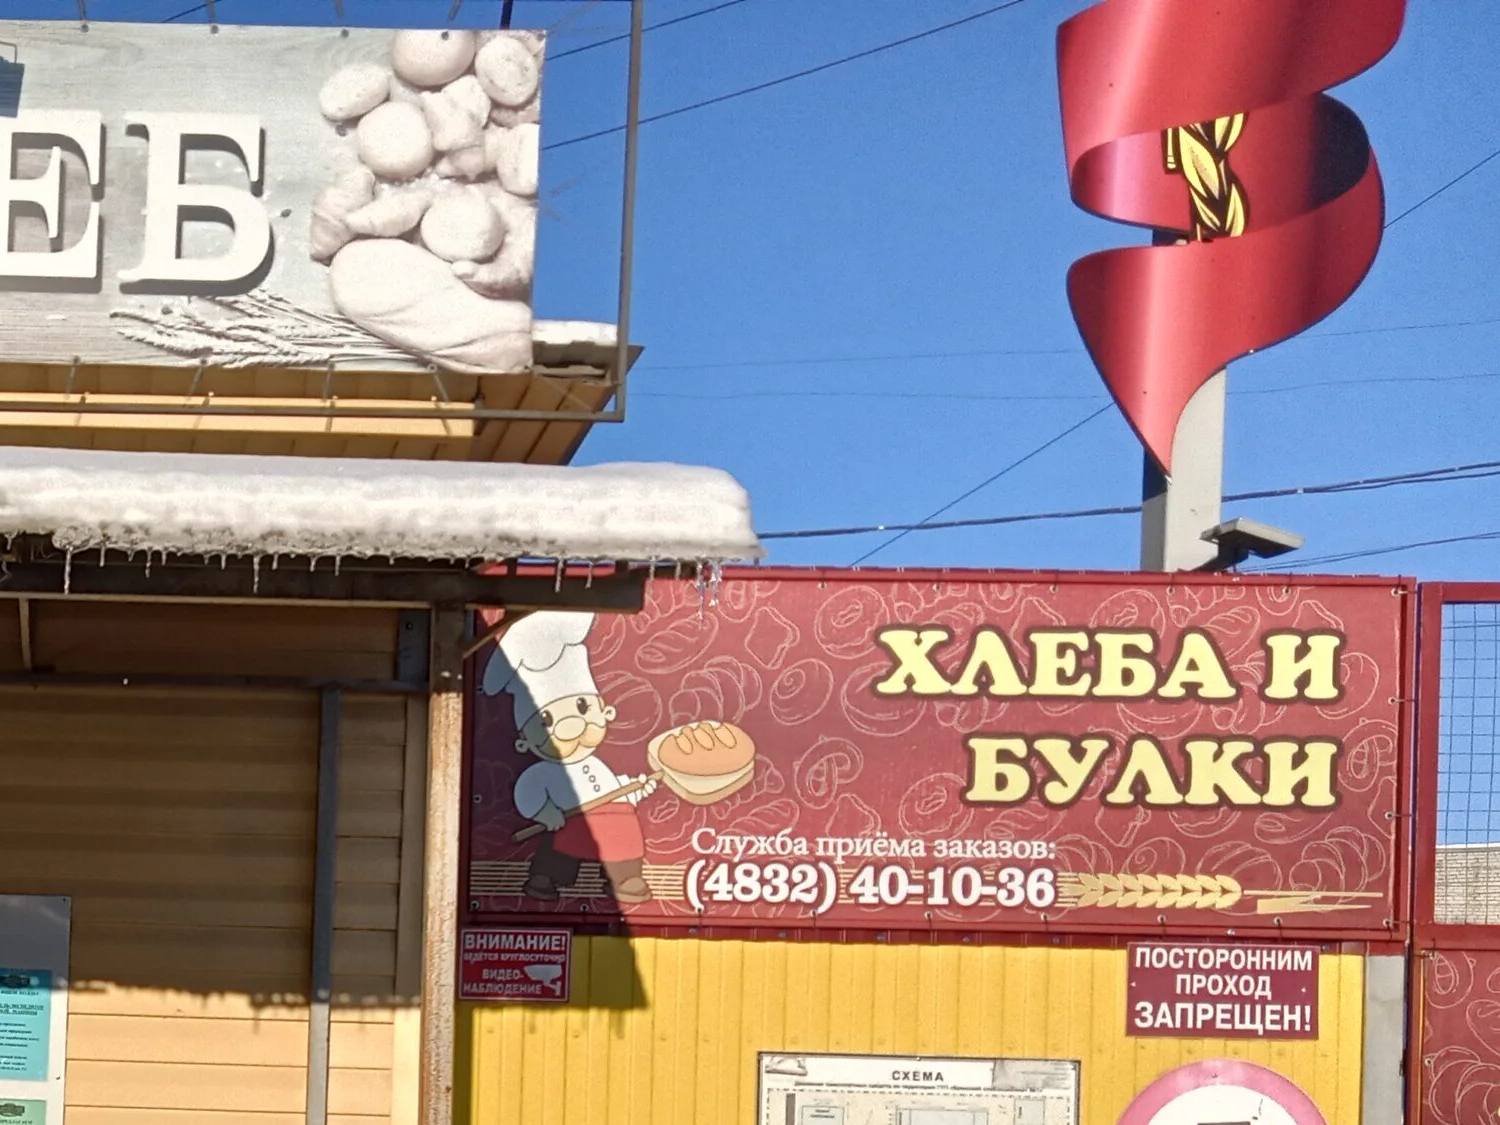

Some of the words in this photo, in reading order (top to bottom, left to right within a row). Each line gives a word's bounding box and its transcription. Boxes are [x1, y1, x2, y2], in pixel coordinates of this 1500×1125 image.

[876, 629, 1237, 699] ХЛЕБА
[1265, 633, 1341, 700] И
[965, 736, 1340, 806] БУЛКИ
[692, 829, 808, 857] Служба
[817, 833, 925, 863] приёма
[932, 839, 1057, 860] заказов:
[686, 861, 838, 915] (4832)
[847, 864, 1057, 908] 40-10-36
[464, 933, 566, 951] ВНИМАНИЕ!
[1135, 947, 1313, 971] ПОСТОРОННИМ
[482, 968, 524, 981] ВИДЕО-
[1175, 974, 1272, 1000] ПРОХОД
[463, 983, 542, 995] НАБЛЮДЕНИЕ
[1134, 1001, 1312, 1035] ЗАПРЕЩЕН!
[891, 1070, 944, 1082] СХЕМА
